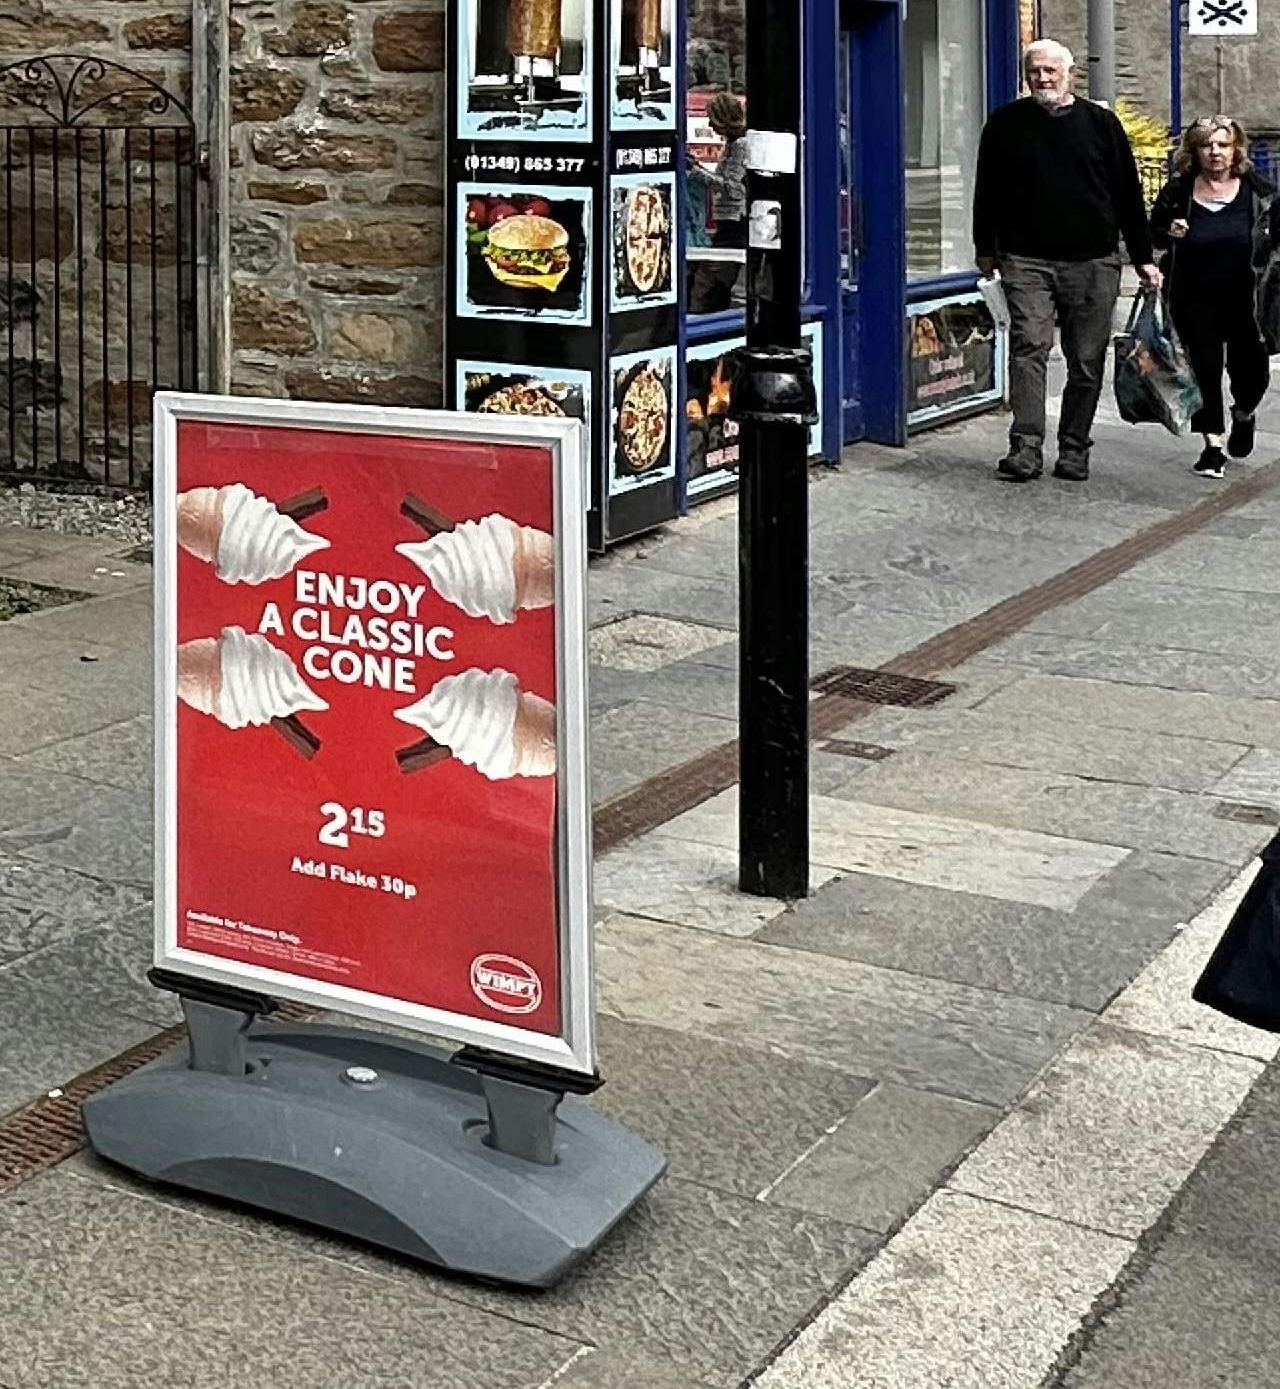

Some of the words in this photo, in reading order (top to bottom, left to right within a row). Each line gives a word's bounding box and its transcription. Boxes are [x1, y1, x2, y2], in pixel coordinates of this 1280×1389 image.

[556, 158, 586, 172] 377
[296, 570, 427, 617] ENJOY
[258, 602, 284, 636] A
[292, 608, 456, 660] CLASSIC
[303, 647, 417, 694] CONE
[291, 856, 326, 878] Add
[330, 864, 378, 889] Flake
[380, 875, 418, 899] 30p
[478, 971, 536, 997] WIMPY
